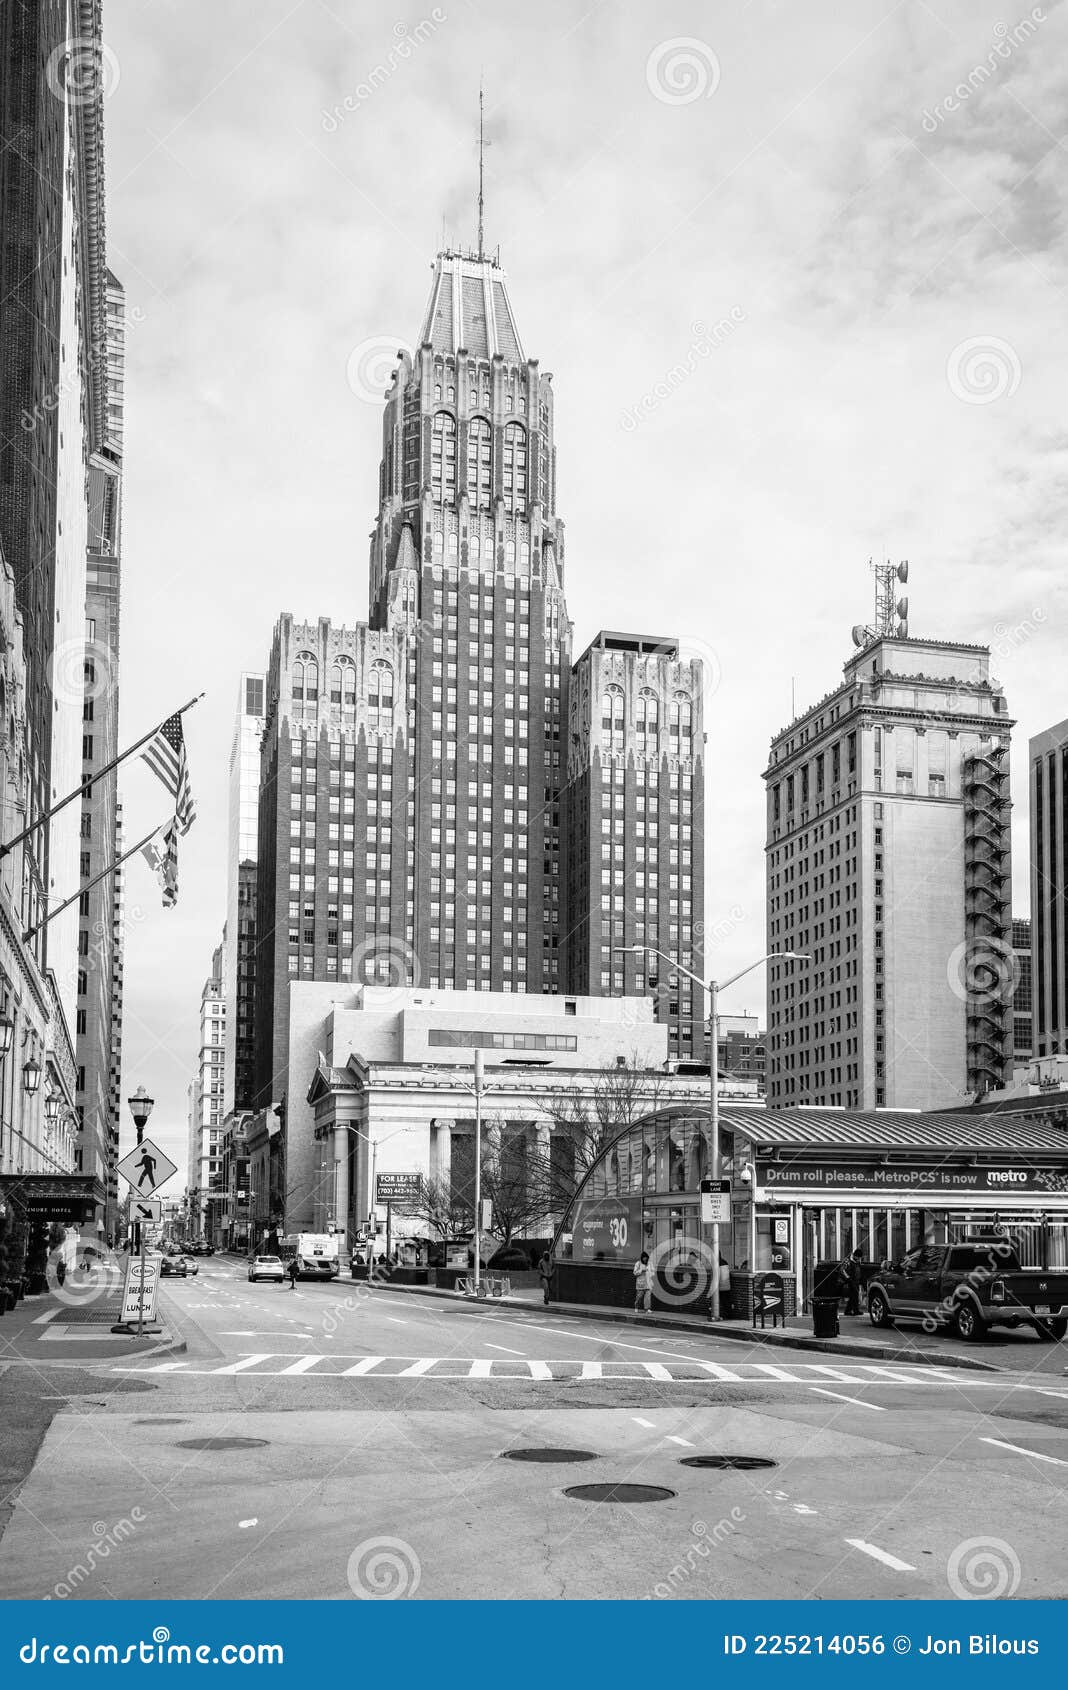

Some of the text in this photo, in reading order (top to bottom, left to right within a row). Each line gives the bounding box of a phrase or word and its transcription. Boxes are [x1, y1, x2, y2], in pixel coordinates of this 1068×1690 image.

[767, 1169, 800, 1180] Drum
[804, 1170, 822, 1181] roll
[942, 1172, 950, 1183] is
[953, 1174, 977, 1183] now
[987, 1170, 1028, 1182] metro
[610, 1217, 628, 1247] $30
[129, 1286, 154, 1295] BREAFAST
